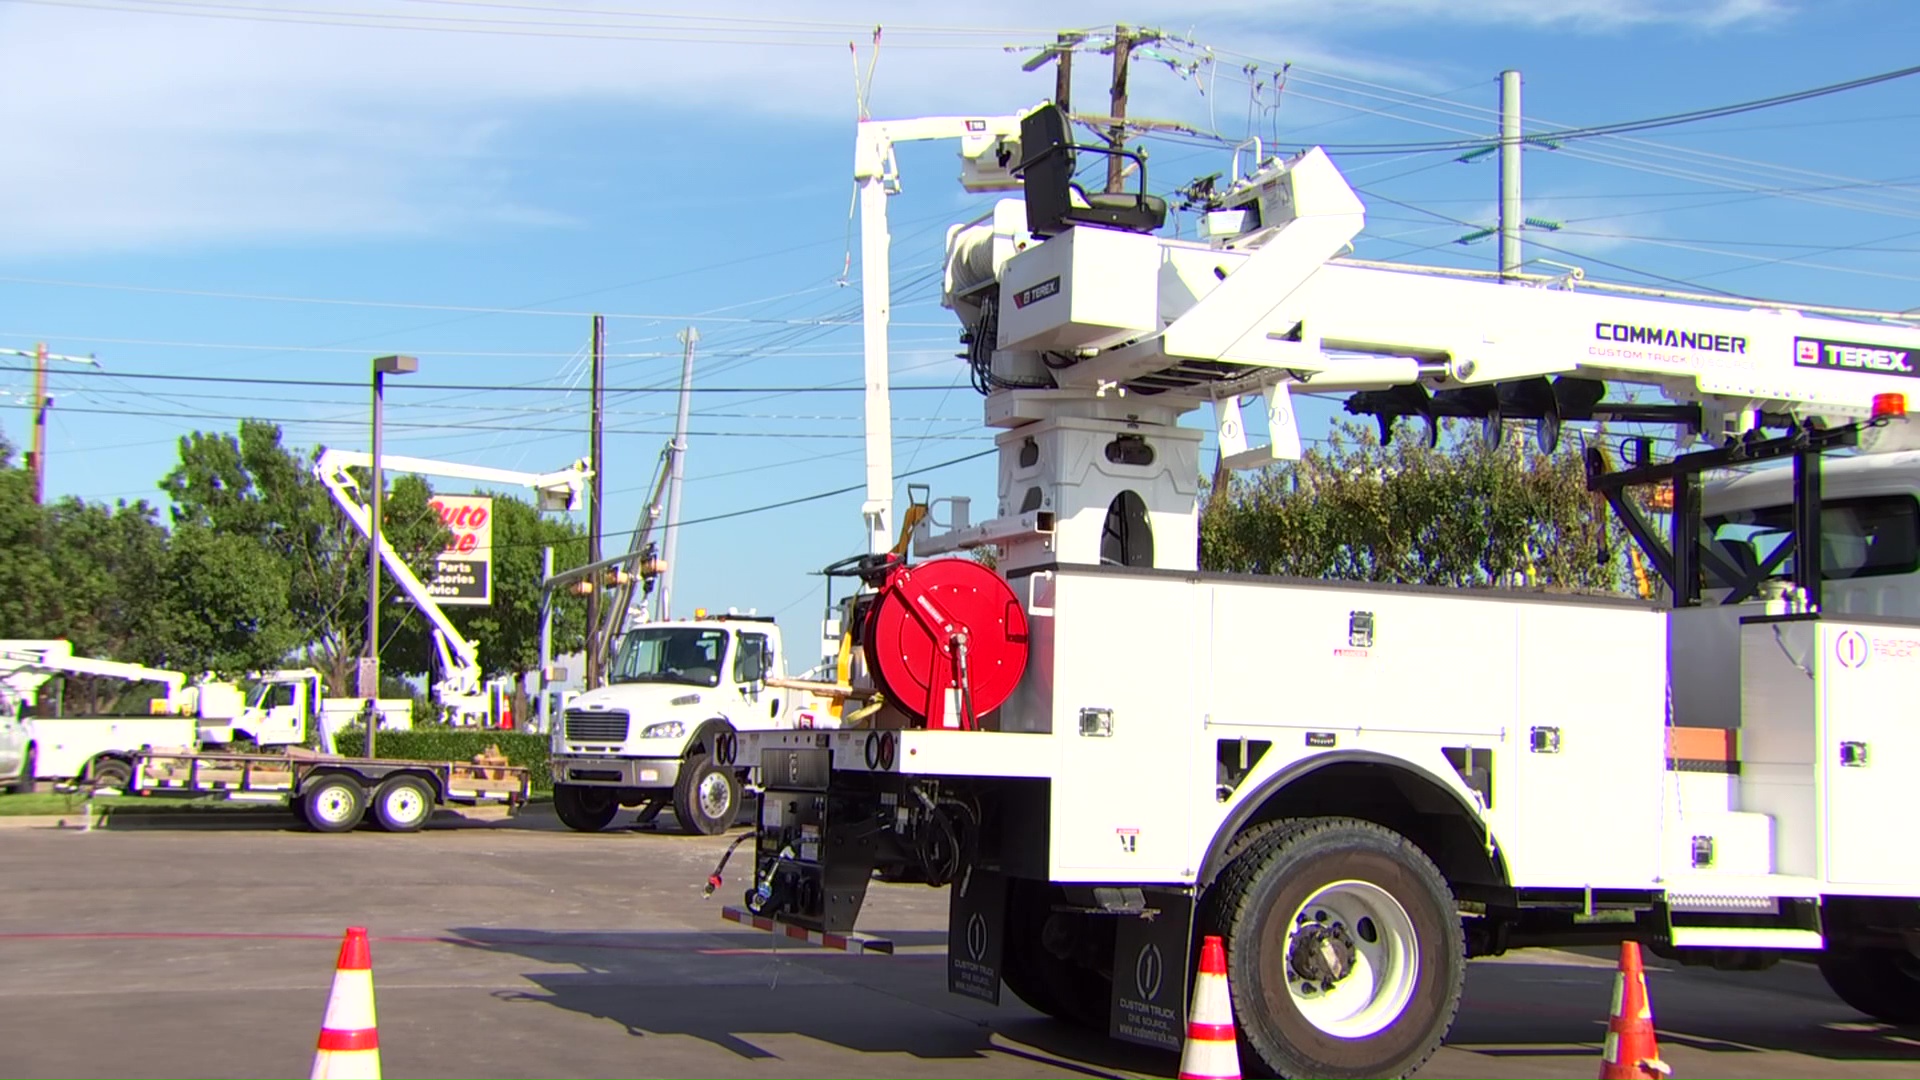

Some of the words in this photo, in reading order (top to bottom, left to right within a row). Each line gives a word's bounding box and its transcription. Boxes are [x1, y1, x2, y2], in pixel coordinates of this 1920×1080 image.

[1031, 280, 1058, 302] TEREX
[1595, 322, 1746, 354] COMMANDER
[1588, 346, 1643, 359] CUSTOM
[1647, 352, 1688, 364] TRUCK
[1823, 344, 1907, 372] TEREX
[438, 561, 471, 573] Parts
[434, 574, 475, 585] sories
[1874, 648, 1912, 658] TRUCK
[1119, 998, 1150, 1014] CUSTOM
[1150, 1004, 1176, 1020] TRUCK
